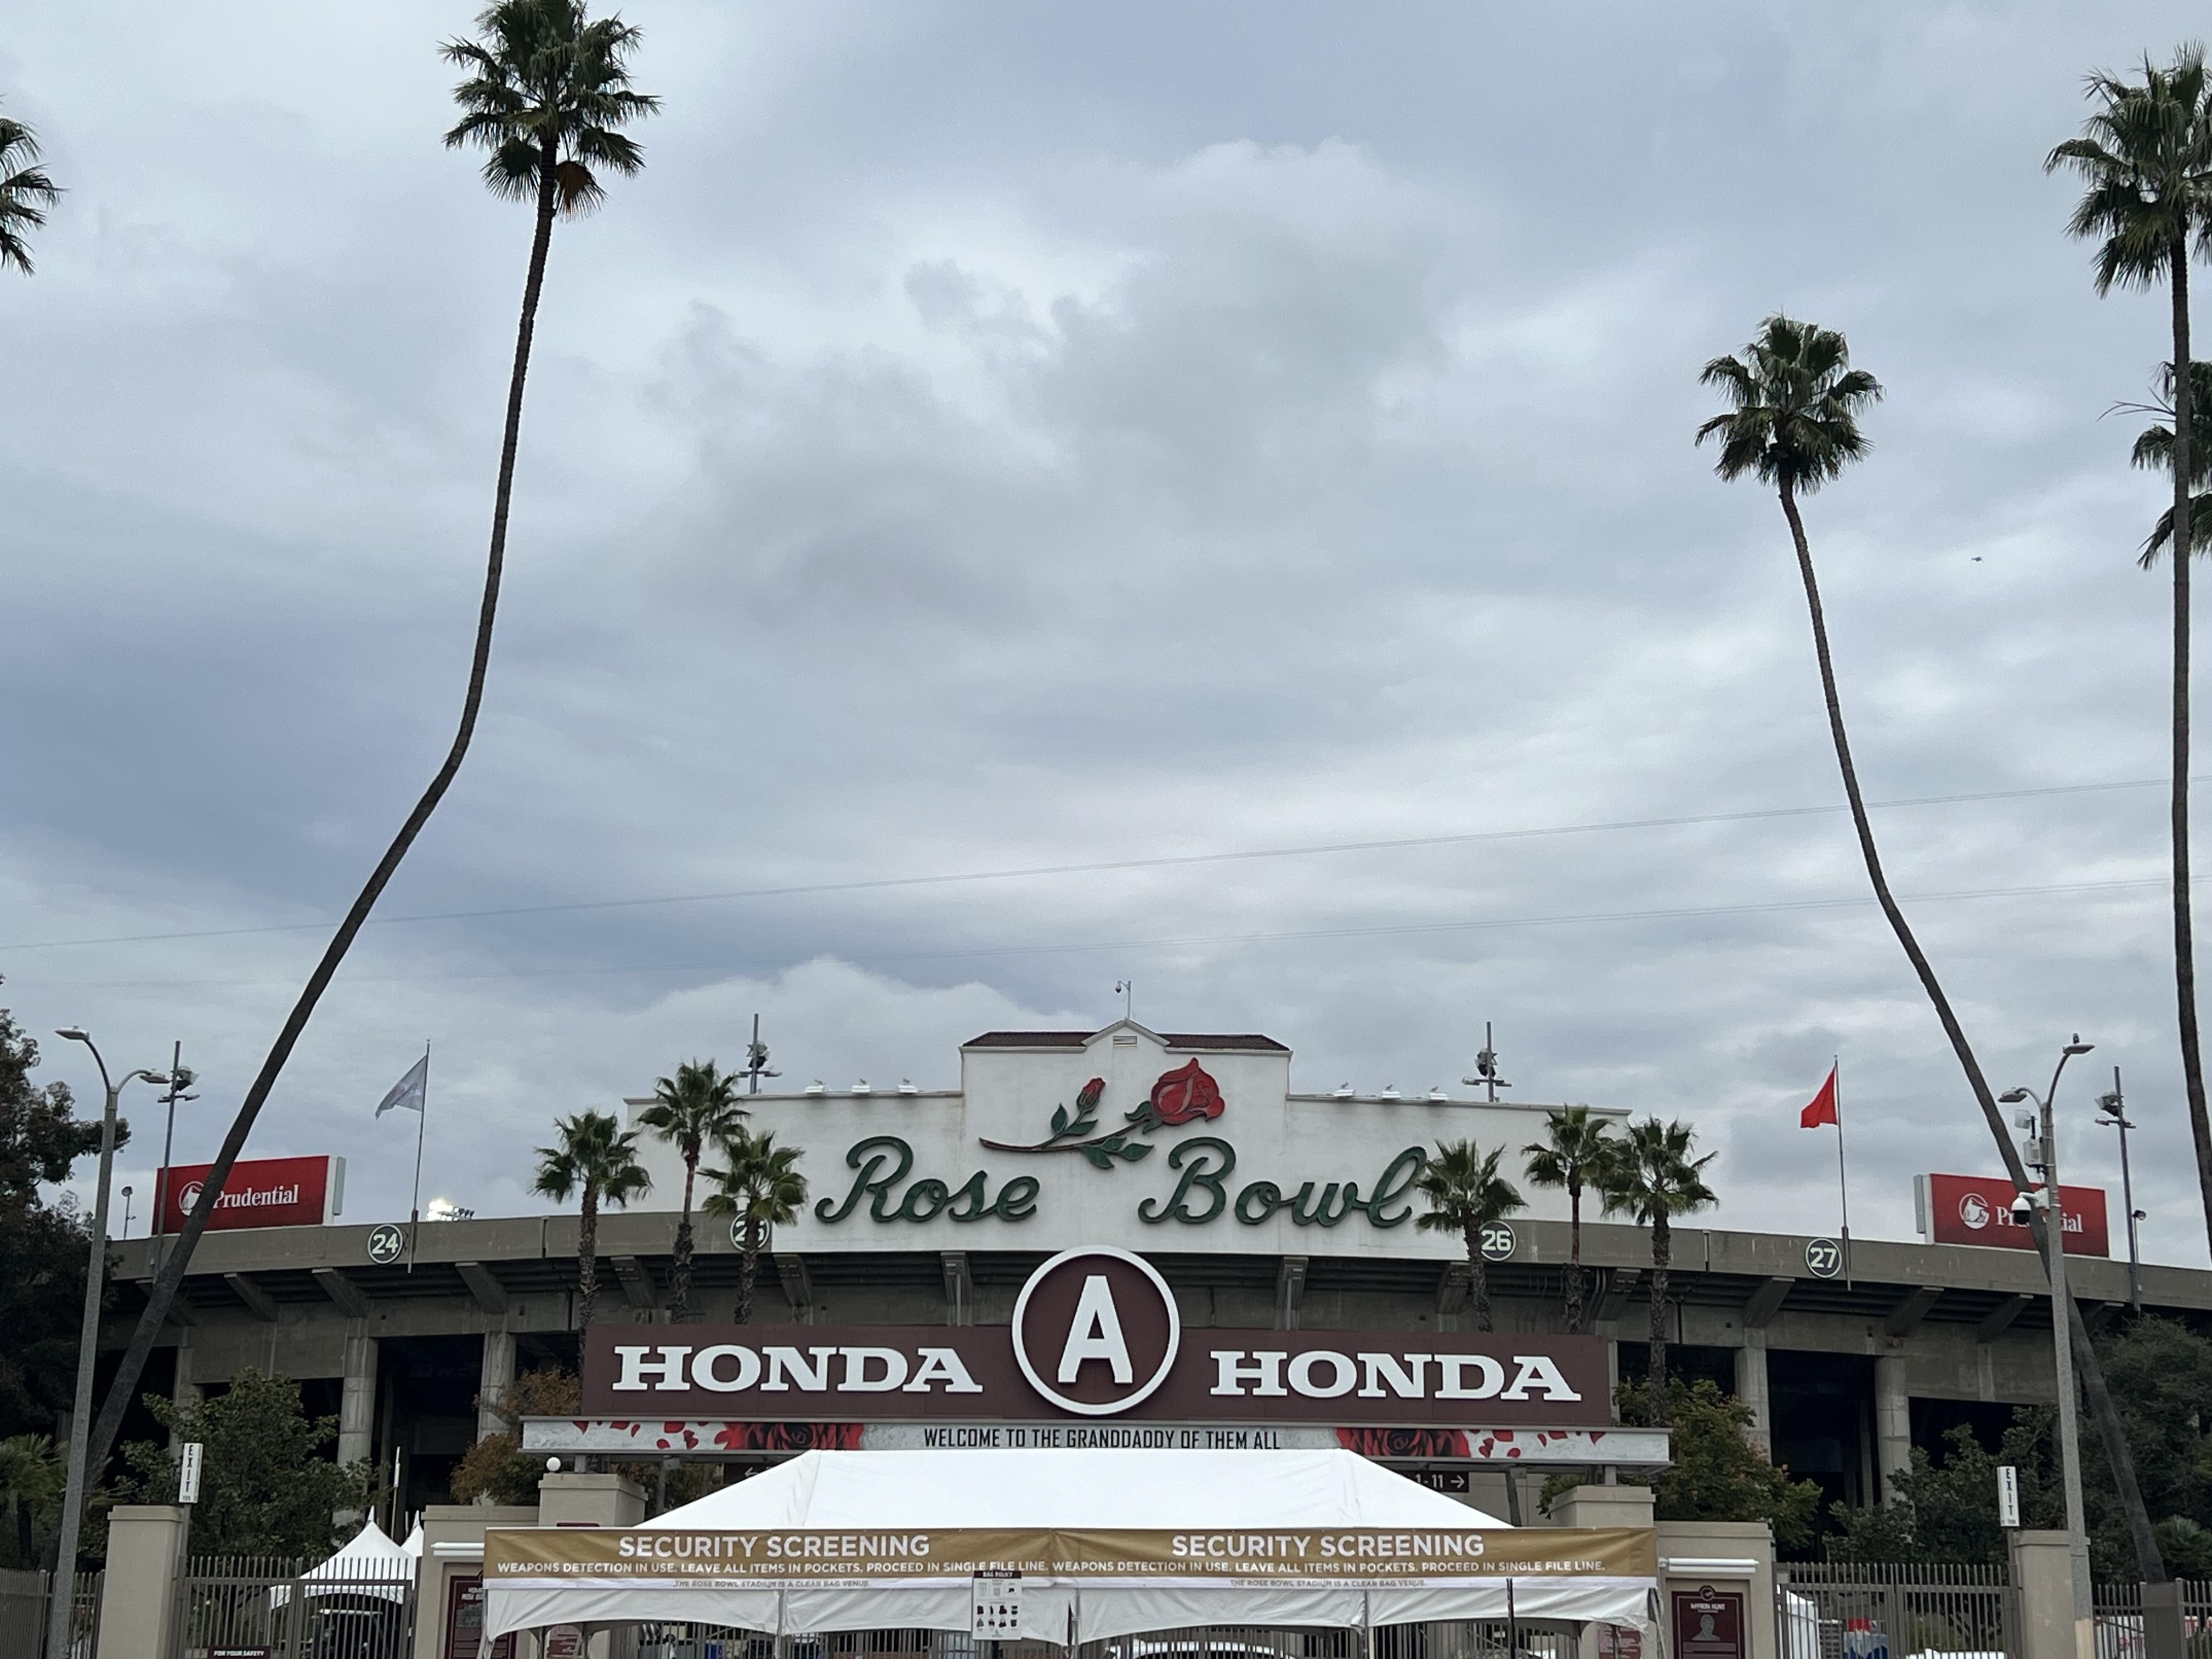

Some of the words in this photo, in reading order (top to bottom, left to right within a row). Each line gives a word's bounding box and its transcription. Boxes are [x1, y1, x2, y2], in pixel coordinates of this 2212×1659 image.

[815, 1136, 1041, 1223] Rose
[1138, 1137, 1427, 1228] Bowl
[372, 1233, 398, 1254] 24
[1482, 1229, 1511, 1251] 26
[1810, 1247, 1837, 1268] 27
[1058, 1276, 1133, 1383] A
[612, 1344, 983, 1393] HONDA
[1210, 1351, 1582, 1402] HONDA
[924, 1428, 1001, 1447] WELCOME
[1006, 1429, 1025, 1447] TO
[1031, 1429, 1060, 1448] THE
[1066, 1429, 1175, 1448] GRANDDADDY
[1181, 1430, 1200, 1448] OF
[1206, 1431, 1247, 1449] THEM
[1254, 1431, 1281, 1449] ALL
[619, 1536, 758, 1558] SECURITY
[766, 1535, 930, 1557] SCREENING
[1172, 1535, 1311, 1557] SECURITY
[1321, 1534, 1485, 1557] SCREENING
[498, 1562, 560, 1573] WEAPONS
[563, 1562, 631, 1573] DETECTION
[635, 1563, 647, 1573] IN
[651, 1563, 677, 1573] USE.
[681, 1563, 720, 1573] LEAVE
[724, 1563, 747, 1573] ALL
[749, 1563, 786, 1573] ITEMS
[788, 1563, 801, 1573] IN
[804, 1562, 864, 1573] POCKETS.
[866, 1562, 923, 1573] PROCEED
[927, 1562, 940, 1572] IN
[943, 1562, 986, 1572] SINGLE
[989, 1561, 1015, 1571] FILE
[1018, 1561, 1048, 1572] LINE.
[1052, 1561, 1114, 1572] WEAPONS
[1117, 1561, 1186, 1572] DETECTION
[1190, 1562, 1202, 1572] IN
[1206, 1562, 1232, 1572] USE.
[1235, 1562, 1274, 1573] LEAVE
[1278, 1562, 1301, 1573] ALL
[1304, 1562, 1340, 1573] ITEMS
[1344, 1562, 1356, 1573] IN
[1359, 1562, 1419, 1573] POCKETS.
[1421, 1562, 1479, 1573] PROCEED
[1483, 1561, 1495, 1572] IN
[1498, 1561, 1542, 1572] SINGLE
[1545, 1561, 1571, 1571] FILE
[1575, 1561, 1606, 1571] LINE.
